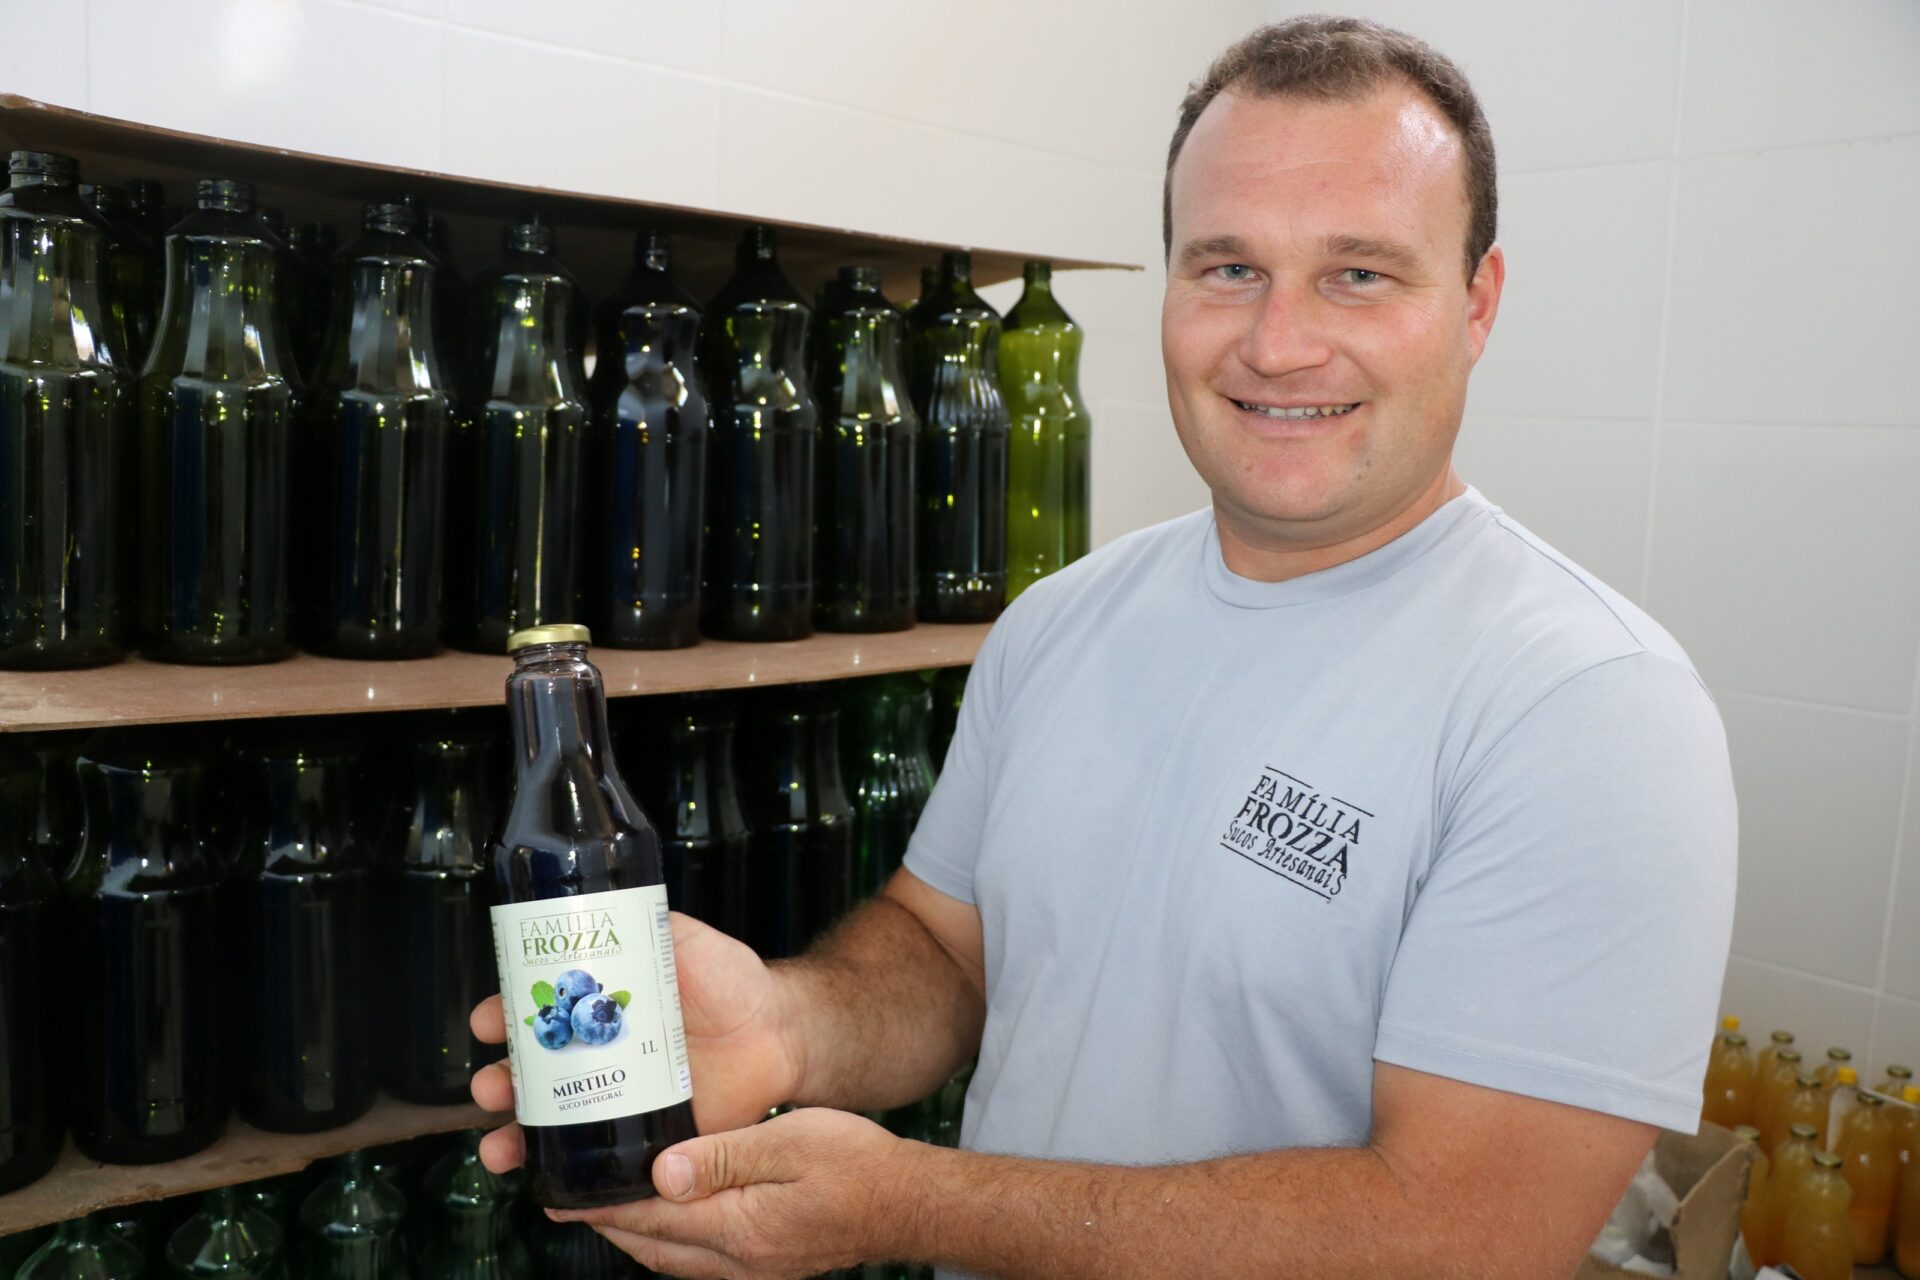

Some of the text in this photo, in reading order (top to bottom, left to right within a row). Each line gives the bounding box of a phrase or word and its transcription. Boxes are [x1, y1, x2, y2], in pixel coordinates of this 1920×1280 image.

[1251, 775, 1361, 844] FAMÍLIA
[1223, 820, 1258, 850] Sucos
[1234, 796, 1348, 874] FROZZA
[522, 928, 620, 956] FROZZA
[553, 1069, 626, 1099] MIRTILO
[558, 1090, 624, 1112] SUCO INTEGRAL
